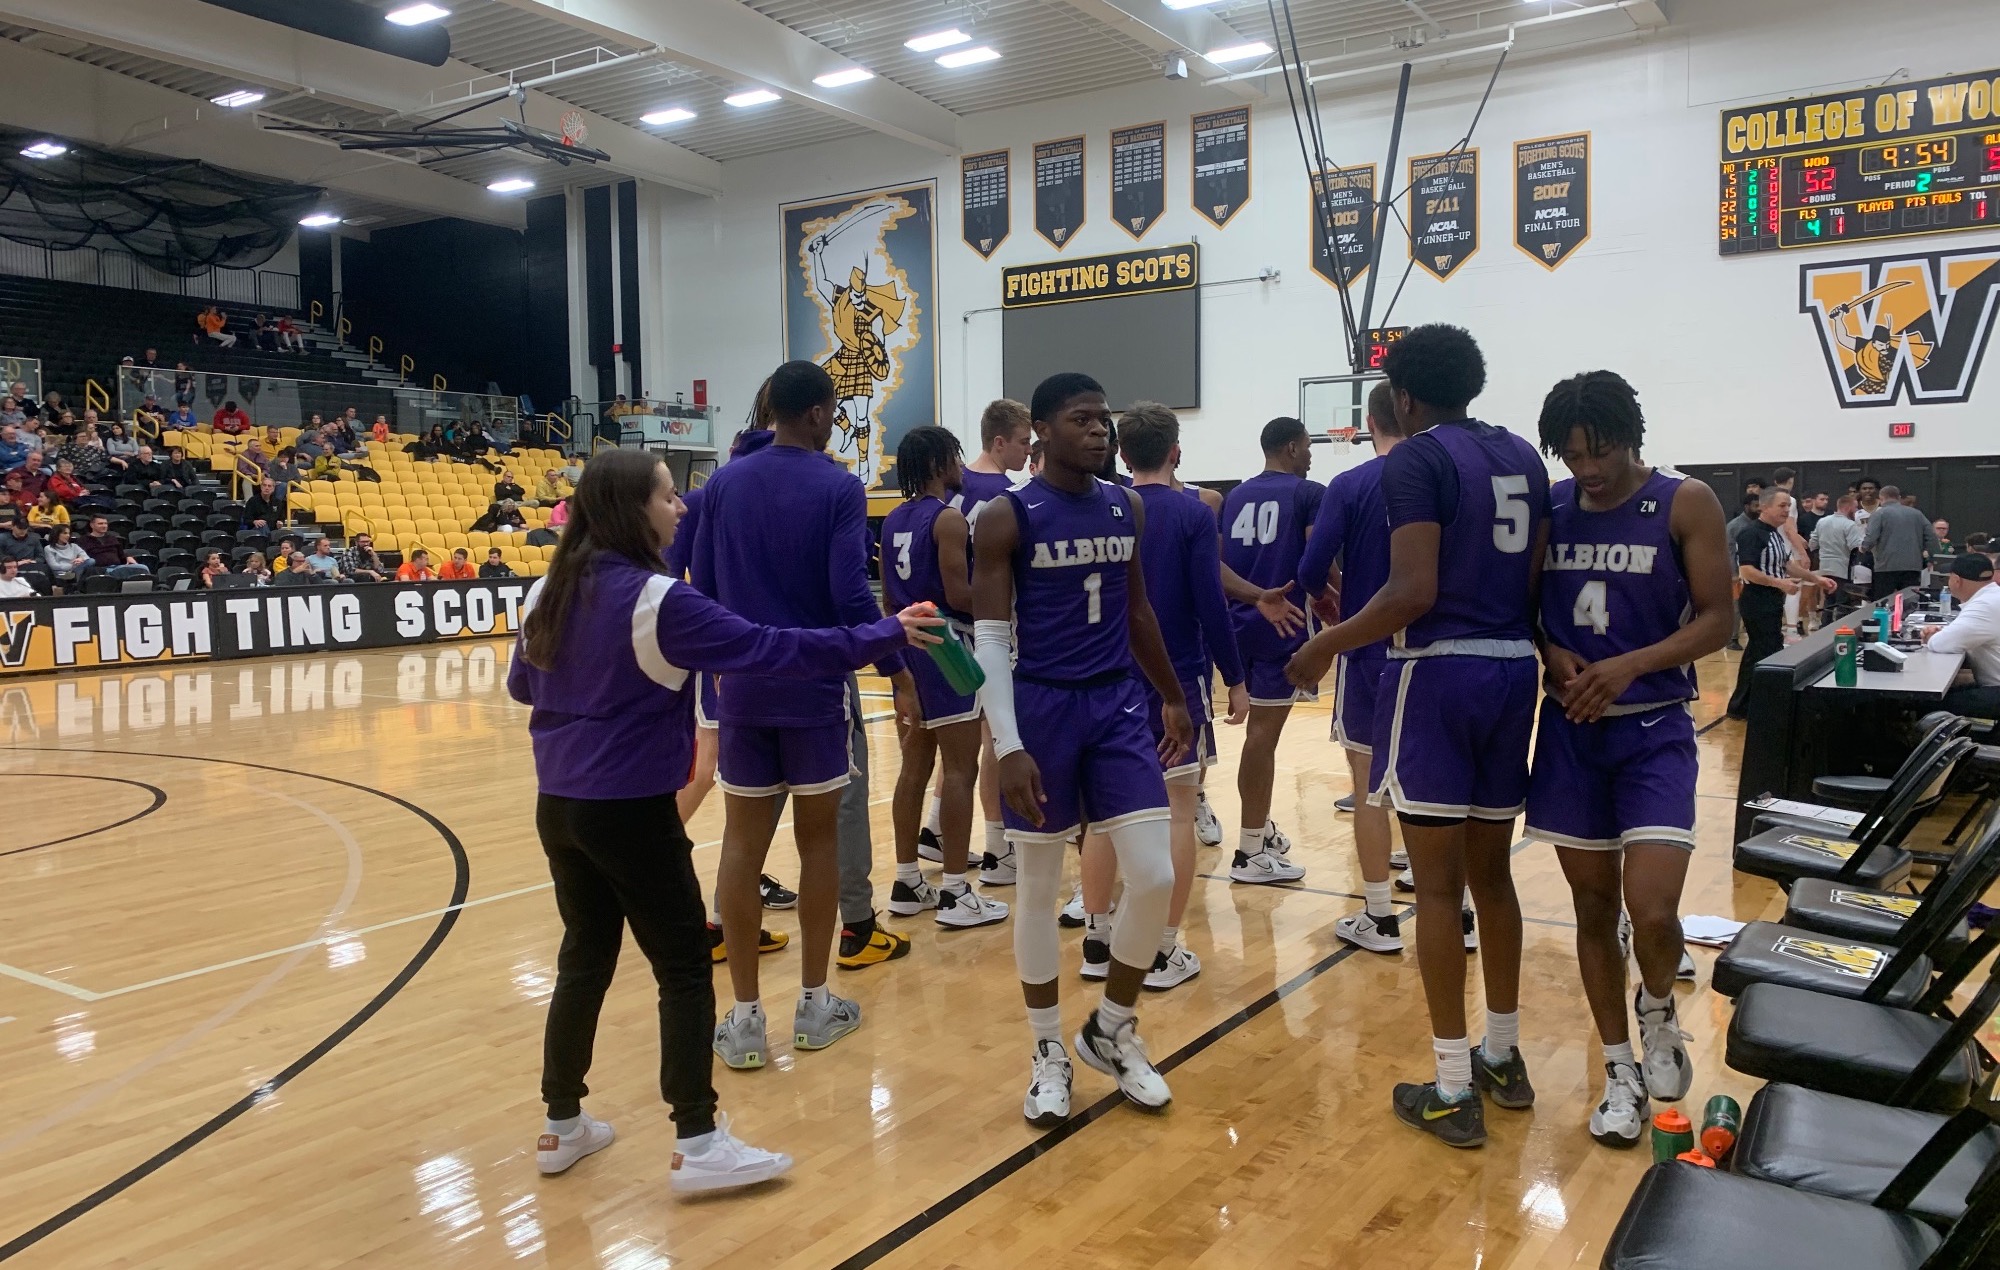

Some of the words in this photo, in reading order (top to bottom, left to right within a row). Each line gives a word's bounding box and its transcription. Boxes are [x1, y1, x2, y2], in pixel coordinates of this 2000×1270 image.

[1727, 98, 1865, 153] COLLEGE
[1875, 90, 1918, 133] OF
[1557, 137, 1585, 145] WOOSTER
[1518, 146, 1557, 168] FIGHTING
[1559, 142, 1585, 159] SCOTS
[1883, 141, 1948, 168] 9:54
[1540, 160, 1564, 171] MEN'S
[1745, 161, 1752, 171] F
[1758, 158, 1776, 169] PTS
[1804, 156, 1830, 168] WOO
[1527, 167, 1577, 180] BASKETBALL
[1723, 164, 1735, 174] NO
[1769, 168, 1778, 180] 2
[1933, 166, 1950, 174] POSS
[1729, 174, 1737, 185] 5
[1749, 170, 1757, 182] 2
[1805, 168, 1836, 192] 52
[1864, 174, 1881, 182] POSS
[1980, 173, 2000, 183] BON
[1769, 182, 1778, 193] 0
[1884, 179, 1916, 190] PERIOD
[1917, 173, 1931, 192] 2
[1333, 190, 1353, 199] MEN'S
[1533, 181, 1571, 201] 2007
[1725, 187, 1737, 198] 15
[1748, 184, 1758, 196] 0
[1969, 191, 1987, 200] TOL
[1322, 197, 1364, 208] BSKETBALL
[1769, 195, 1778, 207] 2
[1809, 193, 1836, 203] BONUS
[1906, 196, 1926, 208] PTS
[1932, 192, 1962, 205] FOULS
[1721, 200, 1737, 212] 22
[1829, 207, 1845, 216] TOL
[1858, 200, 1894, 213] PLAYER
[1535, 207, 1568, 220] NCAA
[1748, 212, 1757, 223] 2
[1769, 209, 1778, 221] 8
[1799, 209, 1817, 220] FLS
[1427, 220, 1459, 233] NCAA
[1524, 221, 1553, 233] FINAL
[1555, 218, 1581, 229] FOUR
[1721, 215, 1737, 226] 24
[1837, 216, 1844, 235] 1
[1769, 223, 1778, 234] 9
[1807, 219, 1820, 236] 4
[1721, 228, 1737, 240] 34
[1006, 263, 1109, 299] FIGHTING
[1116, 253, 1191, 286] SCOTS
[1370, 346, 1388, 367] 2
[1893, 424, 1911, 436] EXIT
[1640, 500, 1657, 513] ZW
[1490, 474, 1530, 553] 5
[1230, 500, 1280, 546] 40
[893, 532, 914, 580] 3
[1083, 573, 1103, 624] 1
[1573, 580, 1610, 636] 4
